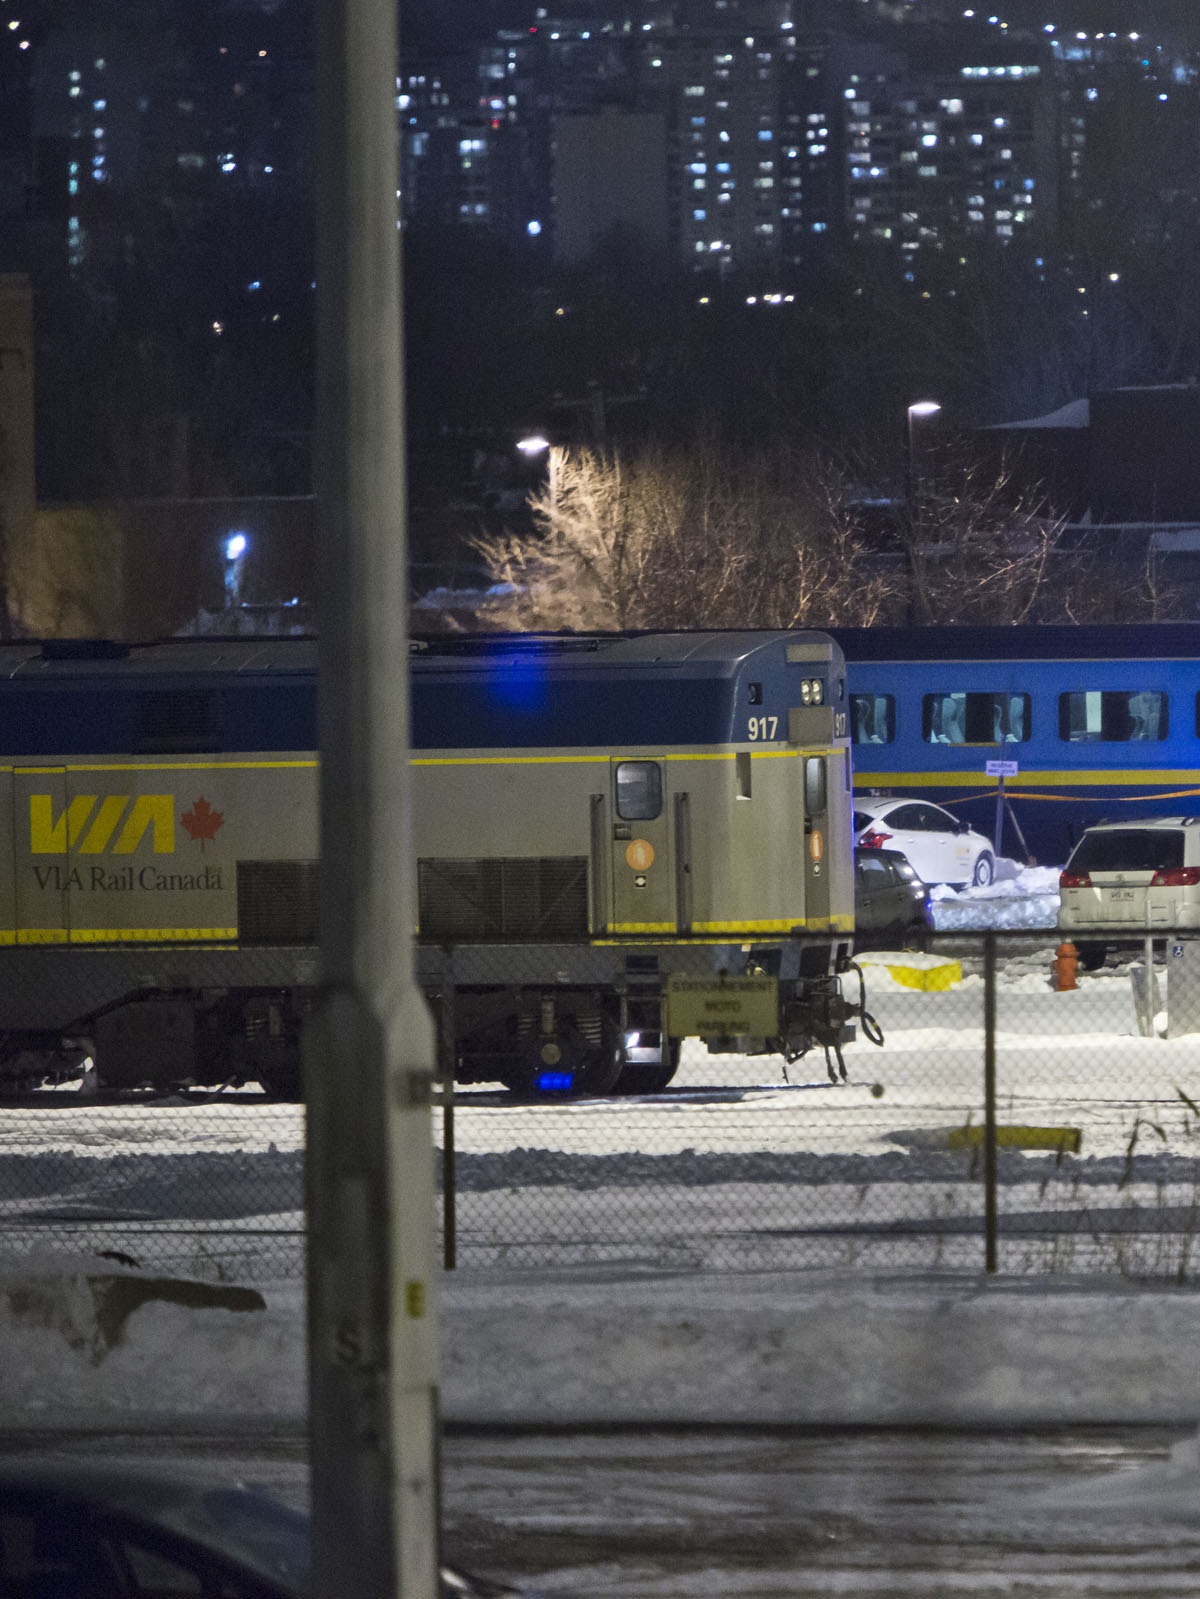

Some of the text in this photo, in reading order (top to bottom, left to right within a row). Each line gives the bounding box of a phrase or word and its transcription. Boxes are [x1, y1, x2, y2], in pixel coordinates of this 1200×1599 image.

[748, 716, 778, 741] 917
[835, 712, 846, 736] 917
[29, 794, 176, 854] VIA
[33, 865, 224, 891] VIA Rail Canada
